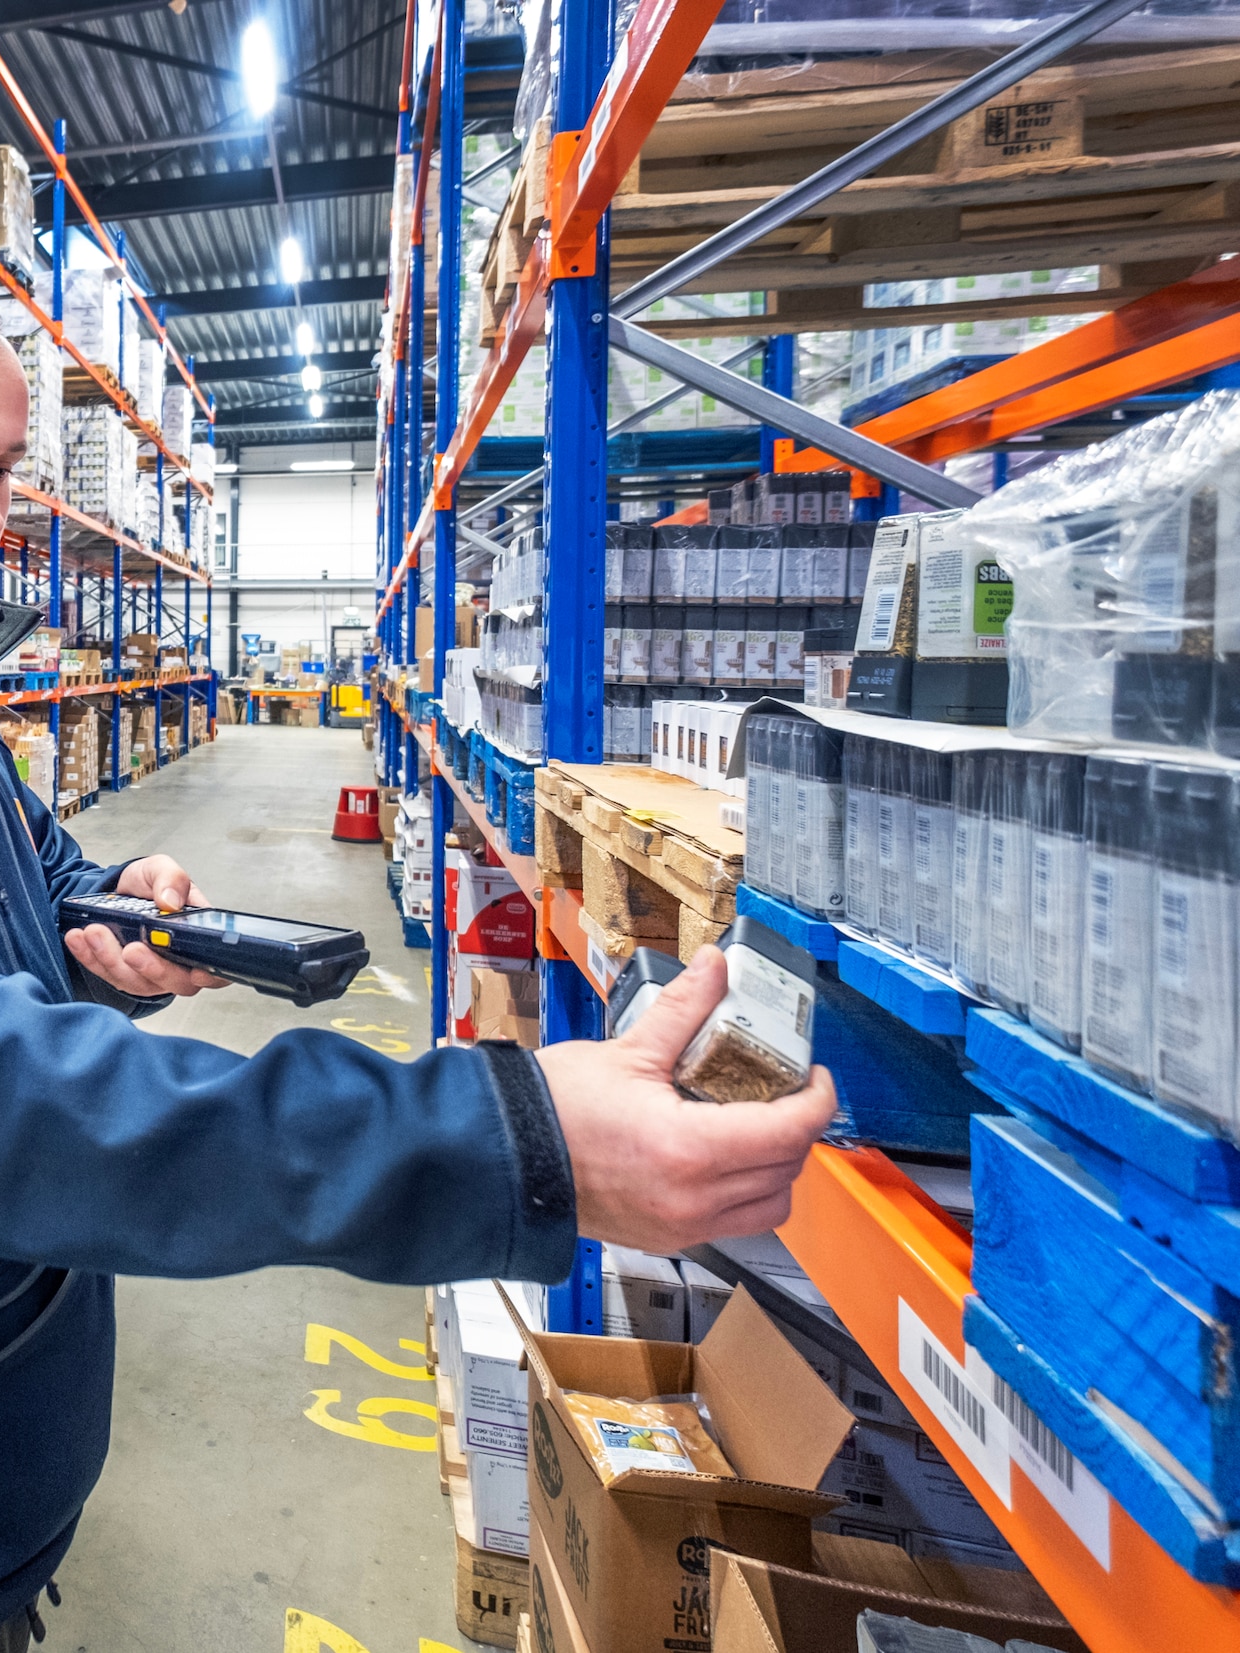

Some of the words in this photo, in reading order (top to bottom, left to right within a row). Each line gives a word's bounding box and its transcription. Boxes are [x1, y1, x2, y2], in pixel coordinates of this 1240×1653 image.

[979, 565, 1012, 582] RBS
[979, 637, 1007, 649] LHAIZE
[471, 1434, 506, 1446] SERENITY
[674, 1613, 710, 1638] FRU
